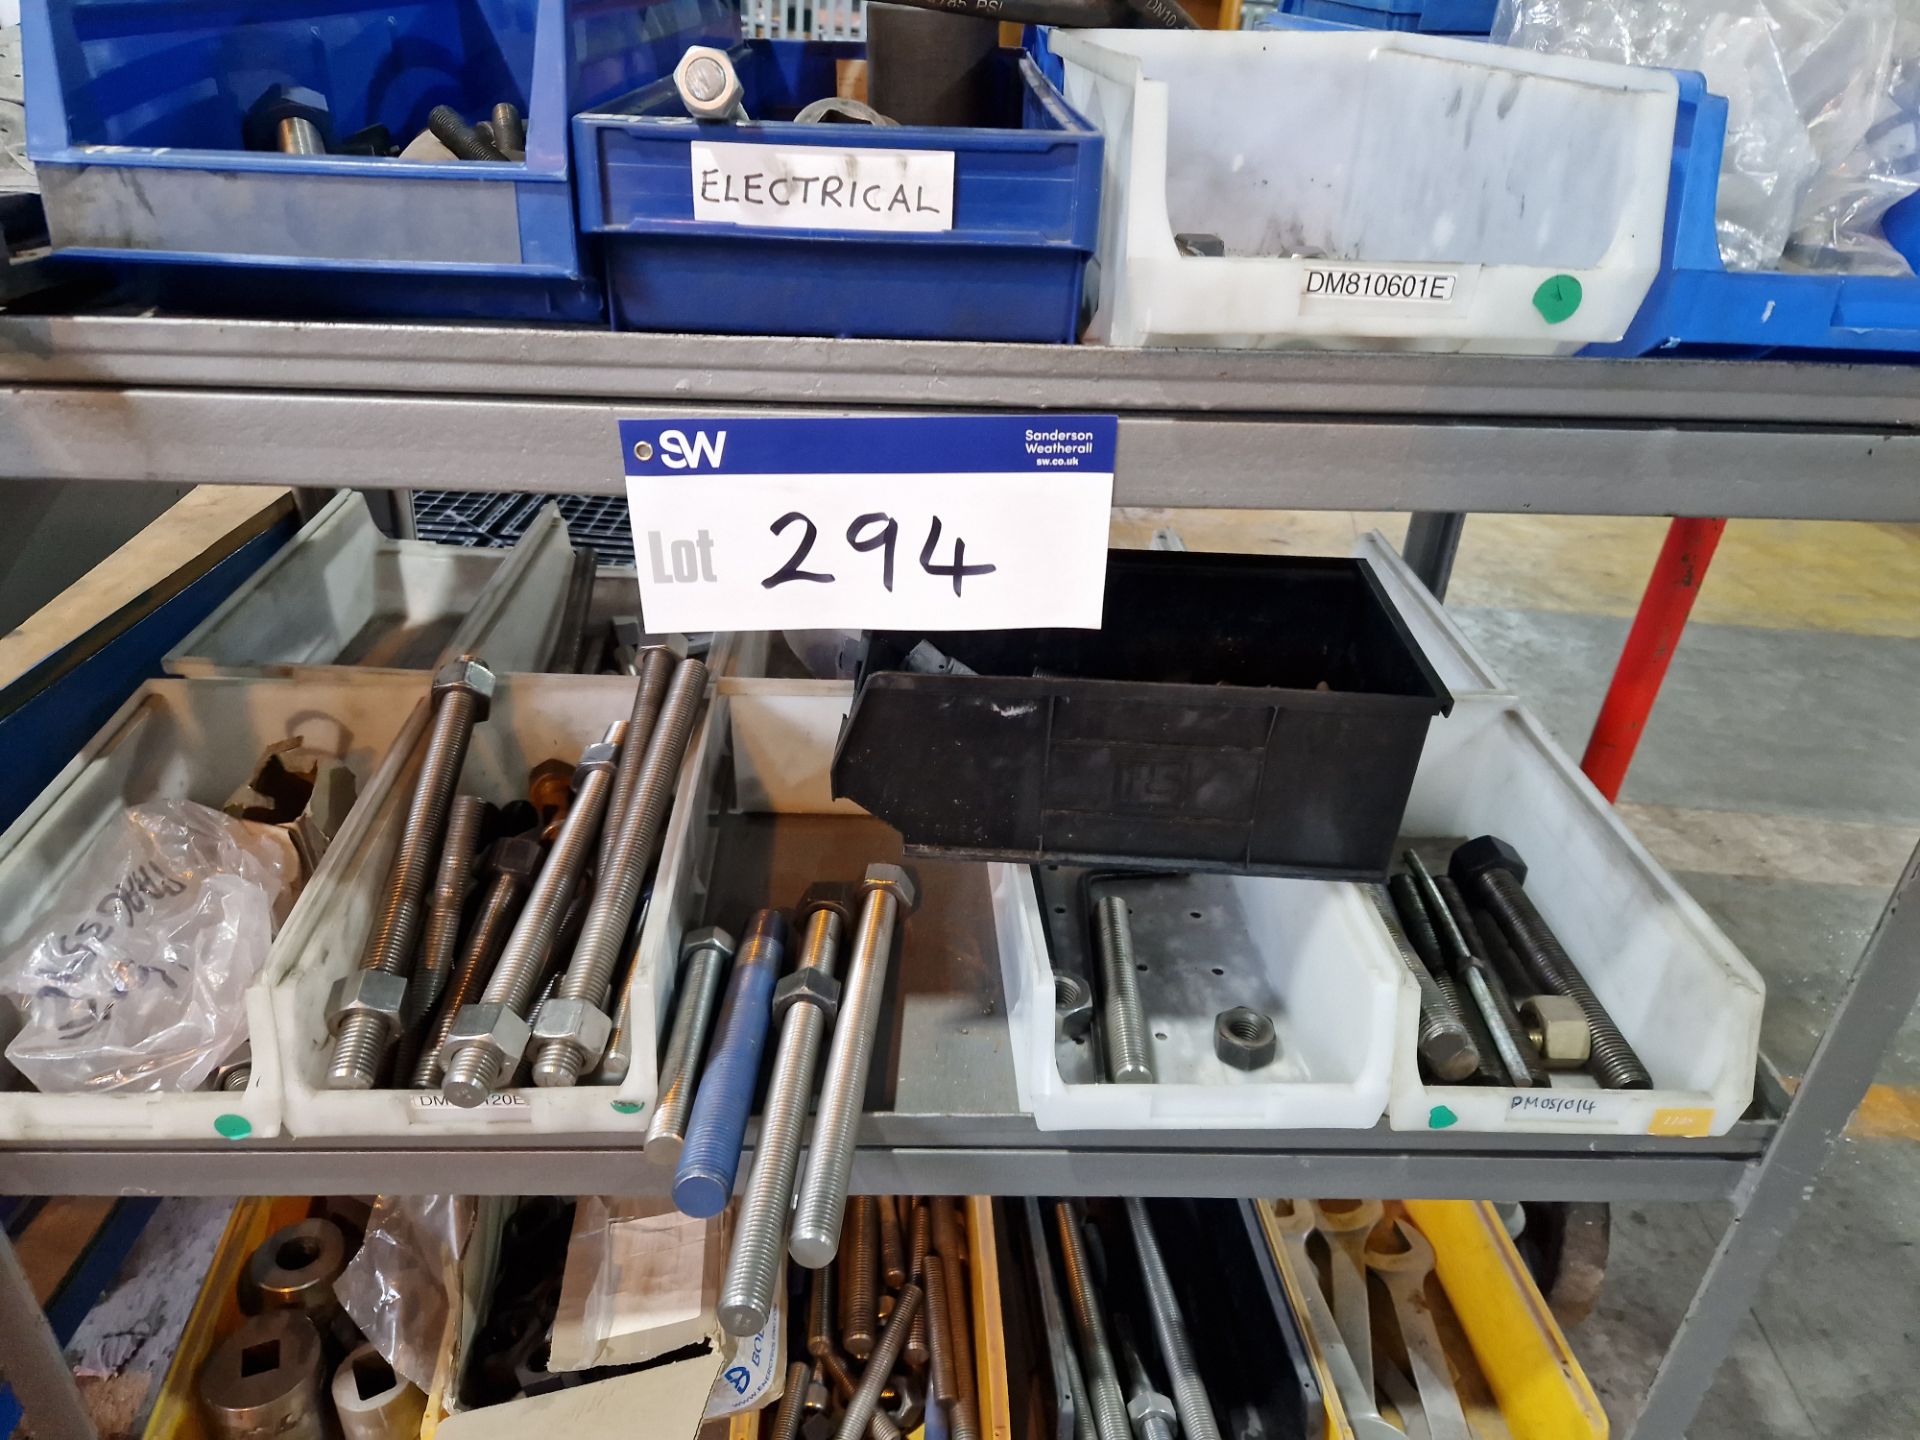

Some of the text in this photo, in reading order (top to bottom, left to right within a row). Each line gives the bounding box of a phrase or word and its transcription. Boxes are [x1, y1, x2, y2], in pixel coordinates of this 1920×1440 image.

[701, 168, 941, 215] ELECTRICAL
[1306, 271, 1449, 299] DM810601E
[659, 429, 727, 469] SW
[1025, 429, 1094, 442] Sanderson
[1025, 442, 1093, 454] Weatherall
[1036, 456, 1080, 467] sw.co.uk
[647, 511, 997, 598] Lot 294
